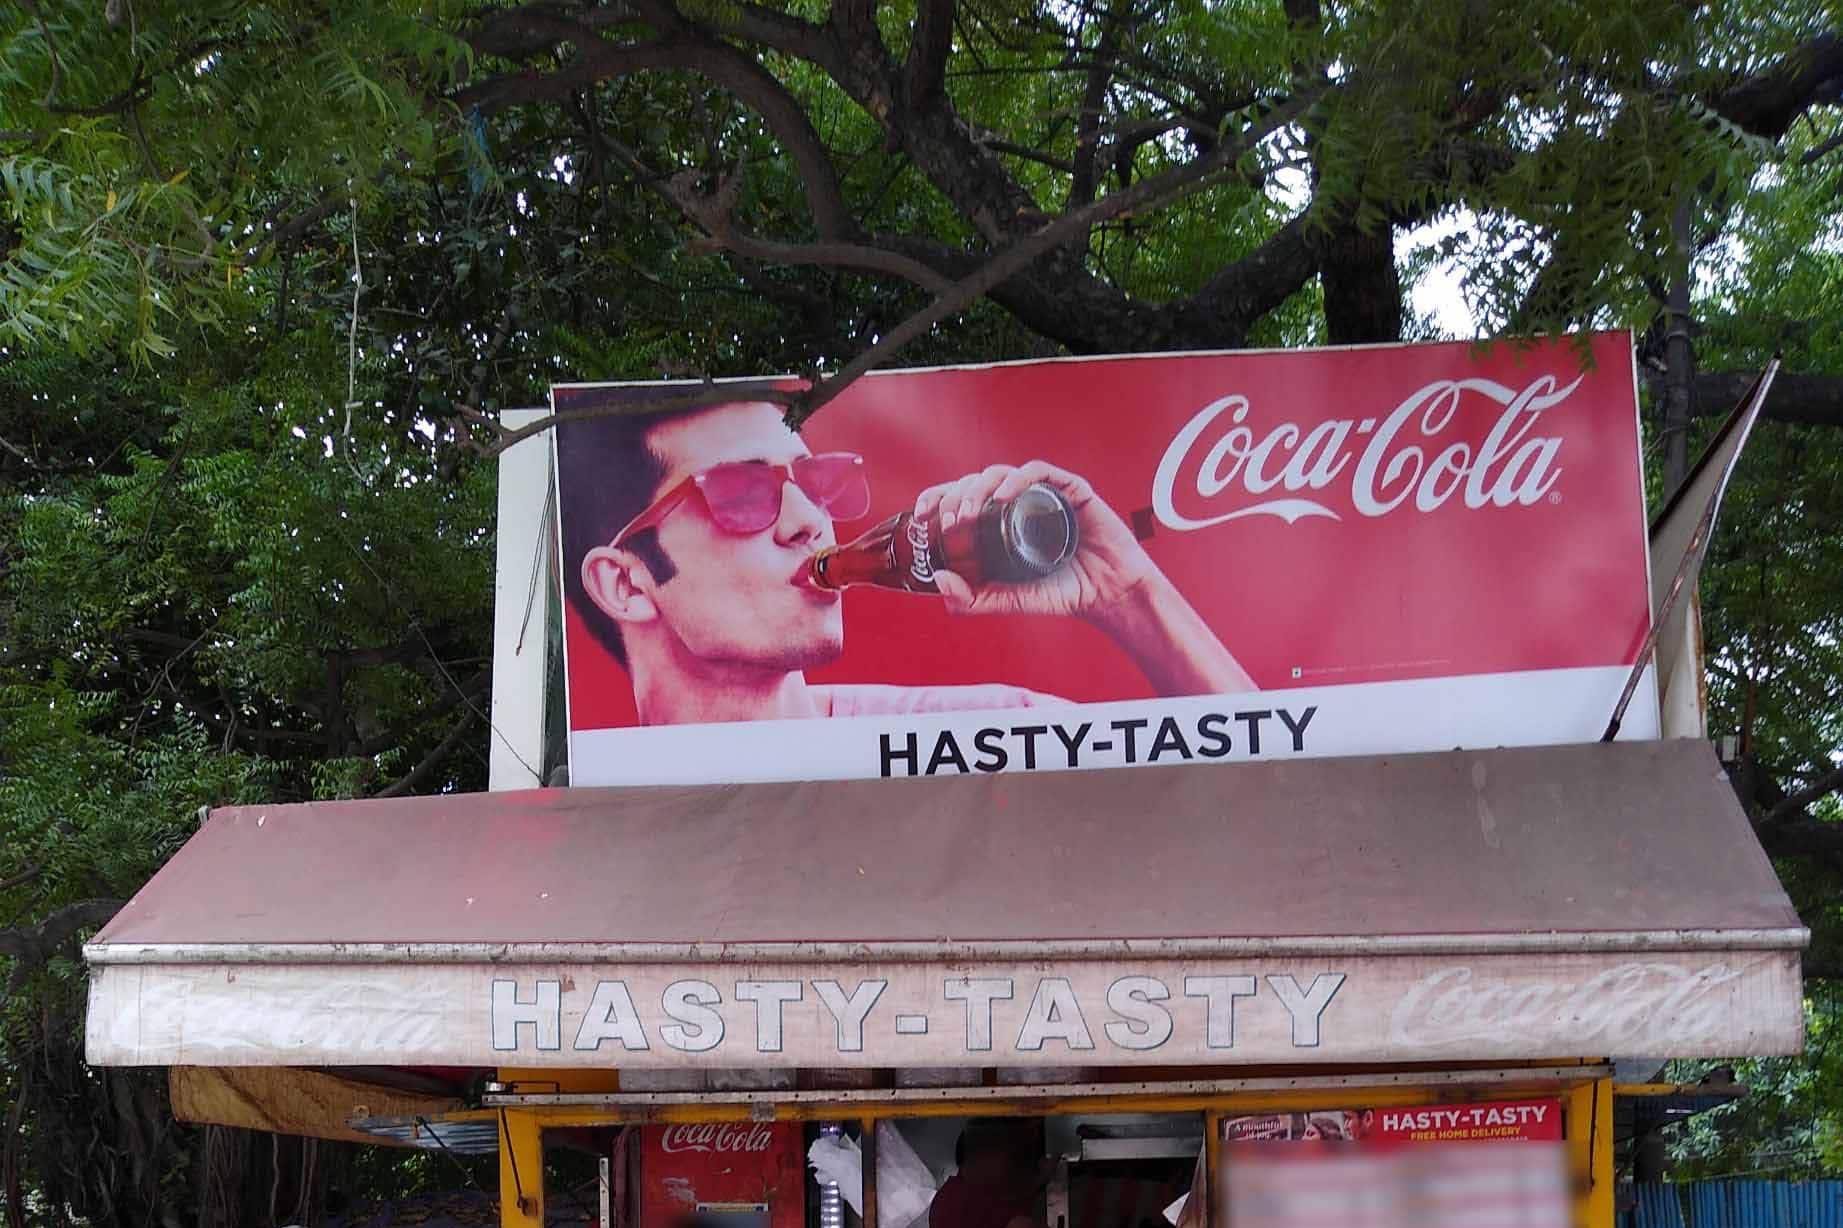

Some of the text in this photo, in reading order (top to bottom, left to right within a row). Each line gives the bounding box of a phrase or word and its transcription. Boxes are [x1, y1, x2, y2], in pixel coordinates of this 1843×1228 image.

[1152, 373, 1585, 531] Coca-Cola
[879, 706, 1318, 778] HASTY-TASTY
[490, 972, 1347, 1052] HASTY-TASTY
[1383, 1105, 1547, 1131] HASTY-TASTY
[1411, 1130, 1437, 1141] FREE
[1439, 1128, 1468, 1139] HOME
[1471, 1126, 1521, 1138] DELIVERY
